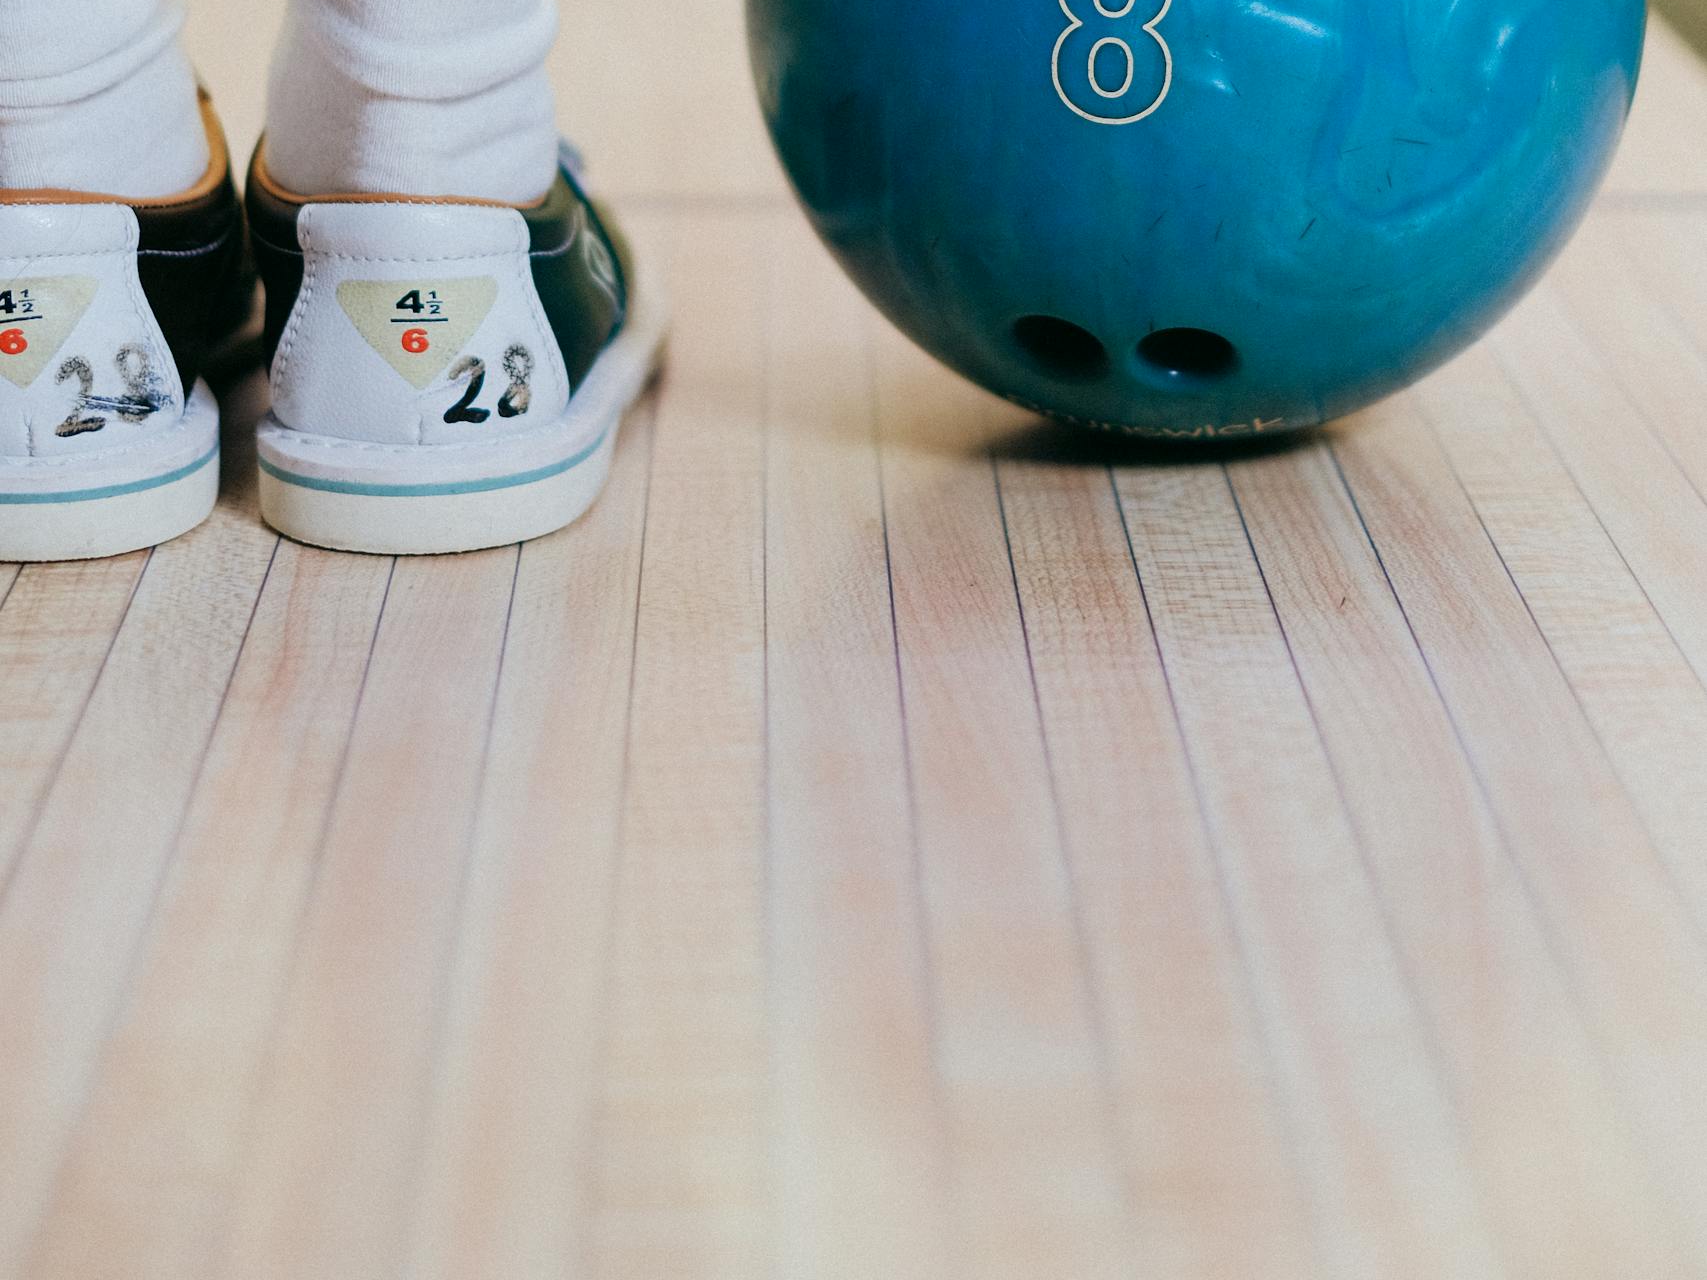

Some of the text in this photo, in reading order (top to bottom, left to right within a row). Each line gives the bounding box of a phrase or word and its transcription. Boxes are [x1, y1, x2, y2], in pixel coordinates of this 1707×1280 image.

[0, 328, 28, 355] 6
[401, 328, 430, 354] 6
[443, 343, 534, 424] 28
